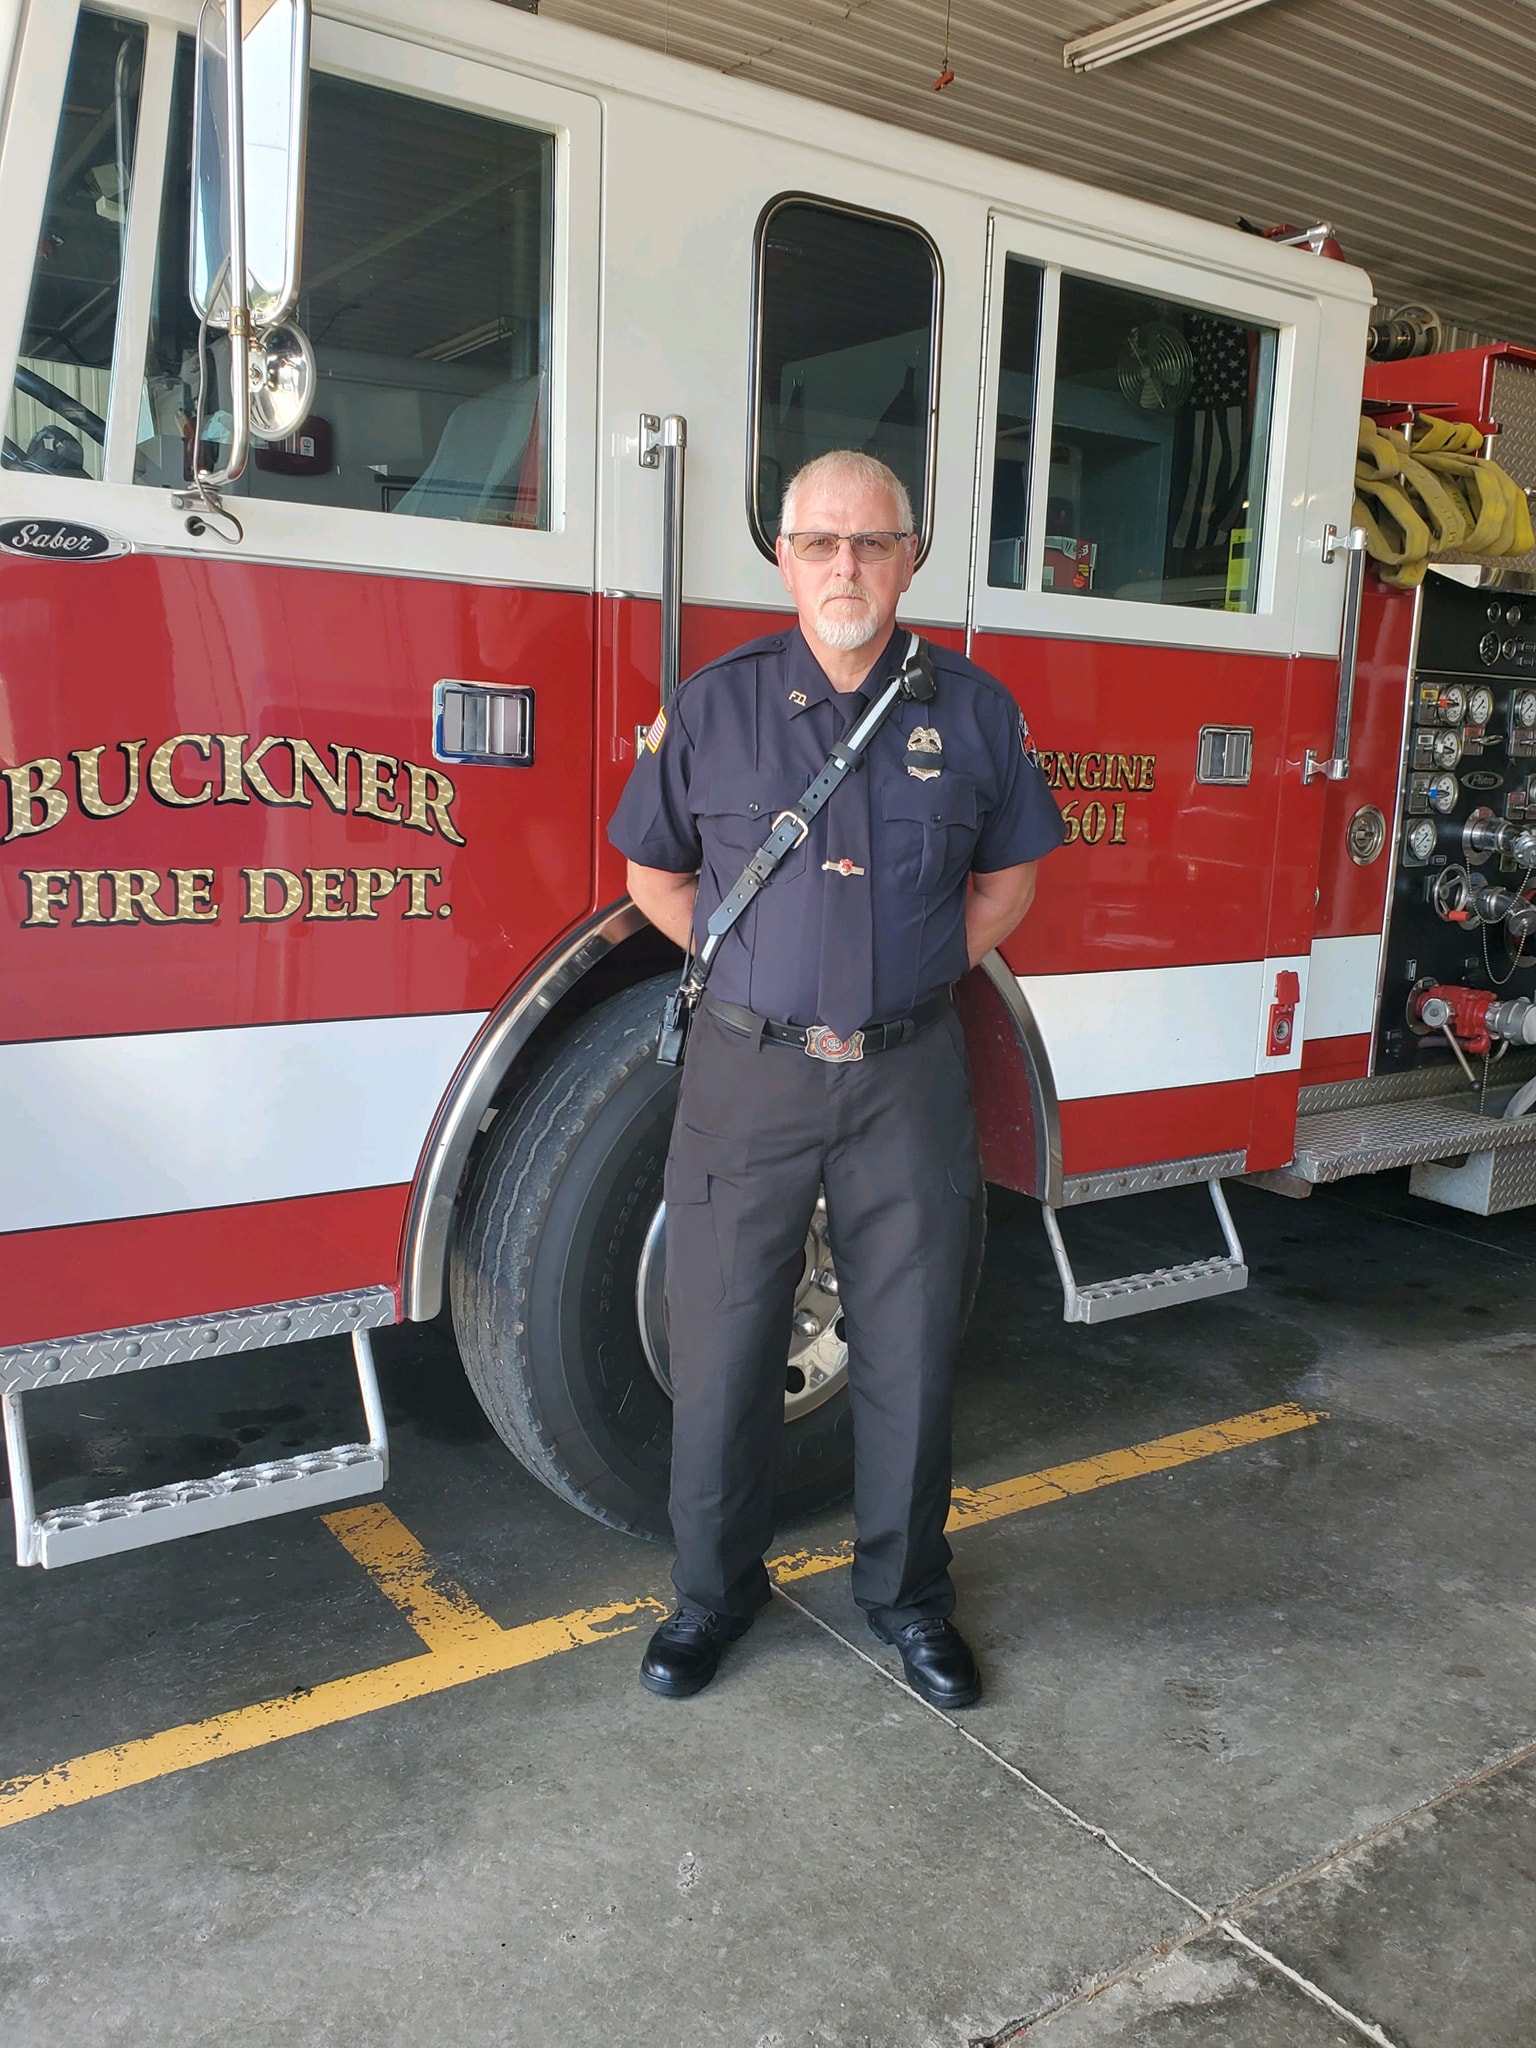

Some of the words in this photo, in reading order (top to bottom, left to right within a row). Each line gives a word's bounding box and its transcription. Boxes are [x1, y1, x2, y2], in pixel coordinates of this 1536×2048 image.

[12, 523, 93, 552] Saber
[2, 733, 466, 846] BUCKNER
[1038, 751, 1156, 790] ENGINE
[1062, 800, 1127, 845] 601
[20, 868, 219, 928] FIRE
[241, 867, 453, 921] DEPT.
